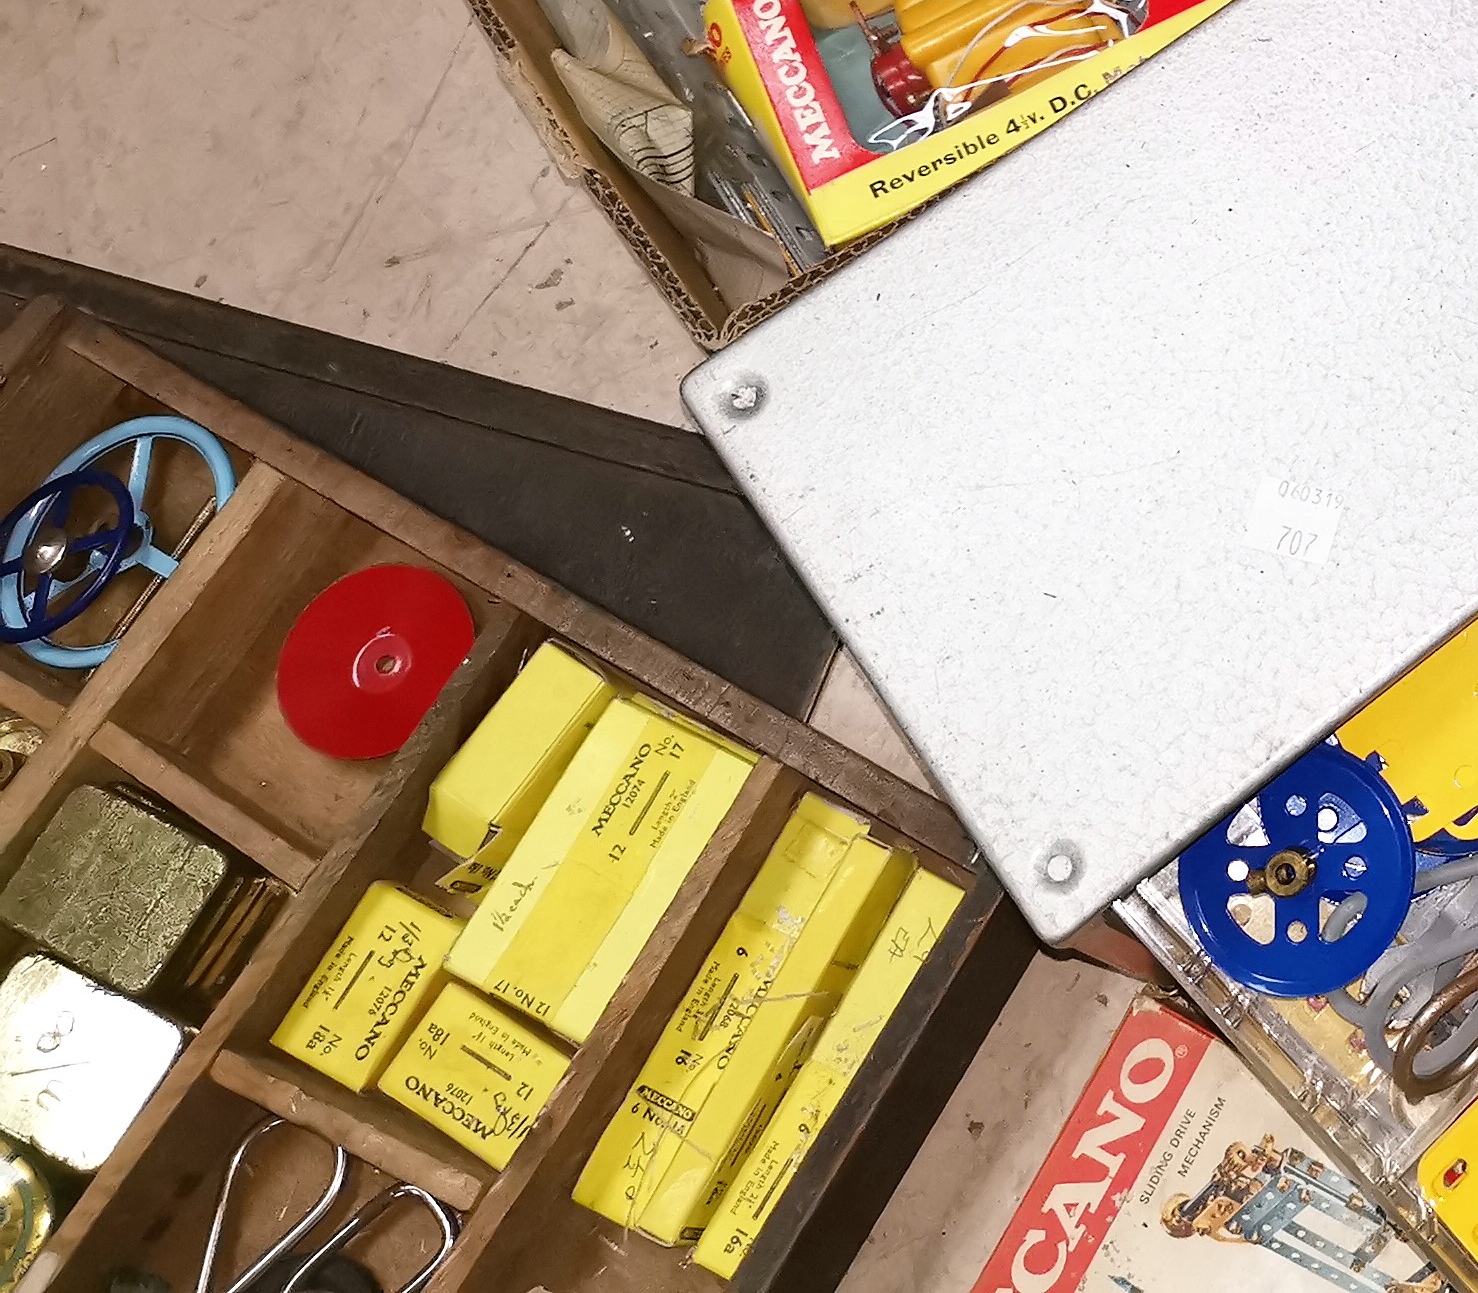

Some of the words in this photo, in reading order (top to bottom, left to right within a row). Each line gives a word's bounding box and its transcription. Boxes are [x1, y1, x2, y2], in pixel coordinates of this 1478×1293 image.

[869, 131, 1000, 198] Reversible
[1049, 82, 1099, 114] D.C.
[1278, 480, 1345, 509] 060319
[1276, 524, 1318, 556] 707
[653, 731, 676, 757] No.
[590, 740, 654, 838] MECCANO
[607, 842, 627, 862] 12
[668, 741, 686, 760] 17
[621, 777, 646, 810] 12074
[649, 824, 668, 849] Made
[663, 813, 675, 824] in
[671, 778, 697, 814] England
[650, 799, 673, 831] Length
[333, 934, 354, 960] Made
[377, 923, 397, 944] 12
[326, 960, 337, 972] in
[734, 945, 750, 959] 6
[331, 951, 357, 984] Length
[701, 960, 720, 986] Made
[301, 972, 330, 1010] England
[493, 977, 511, 994] 17
[508, 984, 536, 1009] No.
[695, 985, 705, 997] in
[698, 976, 721, 1009] Length
[351, 954, 429, 1064] MECCANO
[366, 985, 393, 1017] 12076
[534, 1000, 551, 1017] 12
[674, 996, 700, 1034] England
[718, 997, 742, 1030] 2068
[423, 1021, 451, 1047] 18a
[467, 1009, 501, 1036] England
[499, 1031, 511, 1042] in
[304, 1023, 331, 1052] 18a
[318, 1031, 343, 1060] No.
[413, 1037, 439, 1060] No.
[486, 1038, 516, 1063] Length
[509, 1037, 533, 1057] Made
[673, 1048, 693, 1069] 16
[443, 1081, 474, 1106] 12076
[514, 1080, 535, 1101] 12
[402, 1073, 495, 1142] MECCANO
[629, 1100, 642, 1116] 6
[796, 1121, 813, 1136] 6
[1177, 1096, 1227, 1178] MECHANISM
[759, 1139, 780, 1166] Made
[995, 1038, 1175, 1293] CANO
[1139, 1146, 1174, 1205] SLIDING
[1170, 1107, 1197, 1149] DRIVE
[752, 1166, 764, 1178] in
[754, 1158, 779, 1191] Length
[729, 1179, 755, 1216] England
[722, 1226, 749, 1259] 16a
